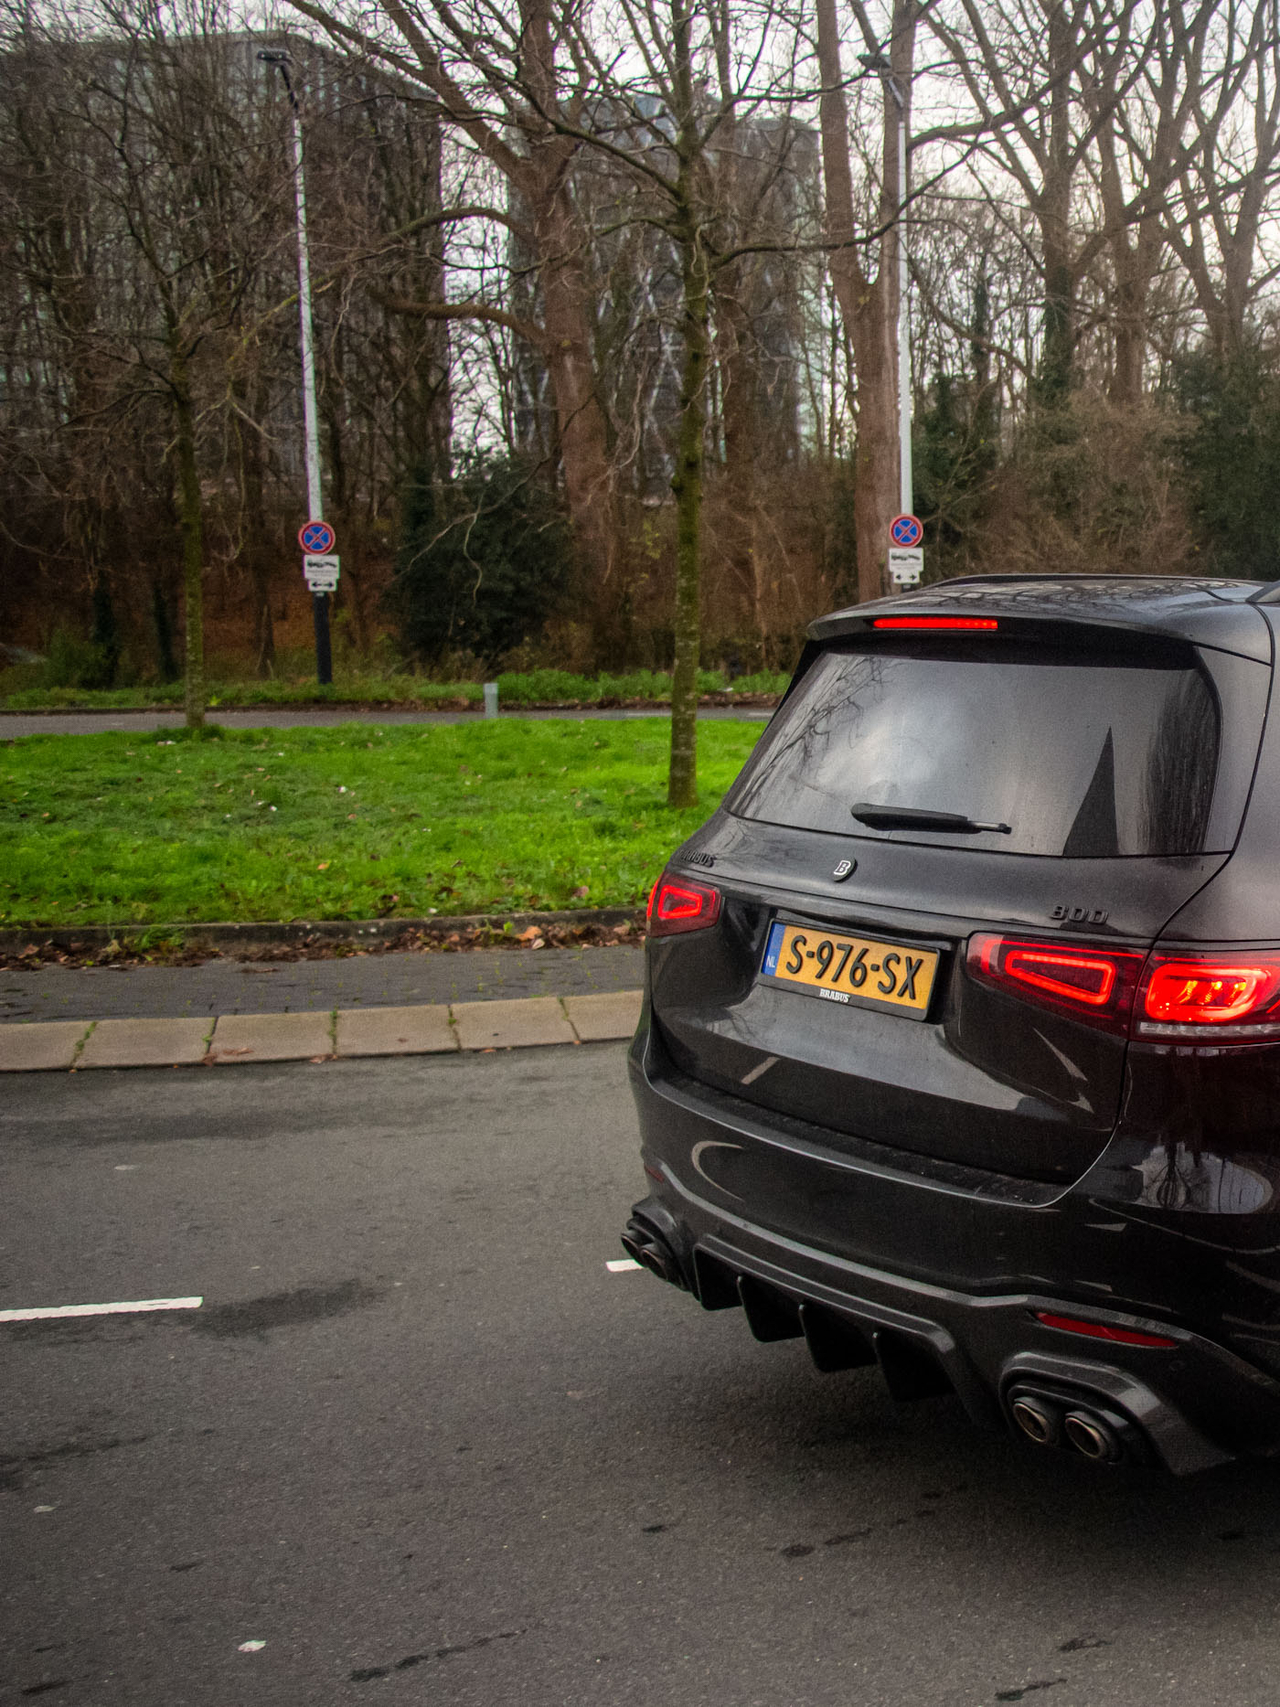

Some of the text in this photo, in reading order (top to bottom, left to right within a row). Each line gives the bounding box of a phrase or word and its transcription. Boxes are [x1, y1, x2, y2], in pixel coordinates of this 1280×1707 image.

[833, 859, 851, 875] B
[1051, 904, 1109, 925] 800
[765, 935, 924, 1000] NL S-976-SX
[819, 988, 851, 1003] BRABUS
